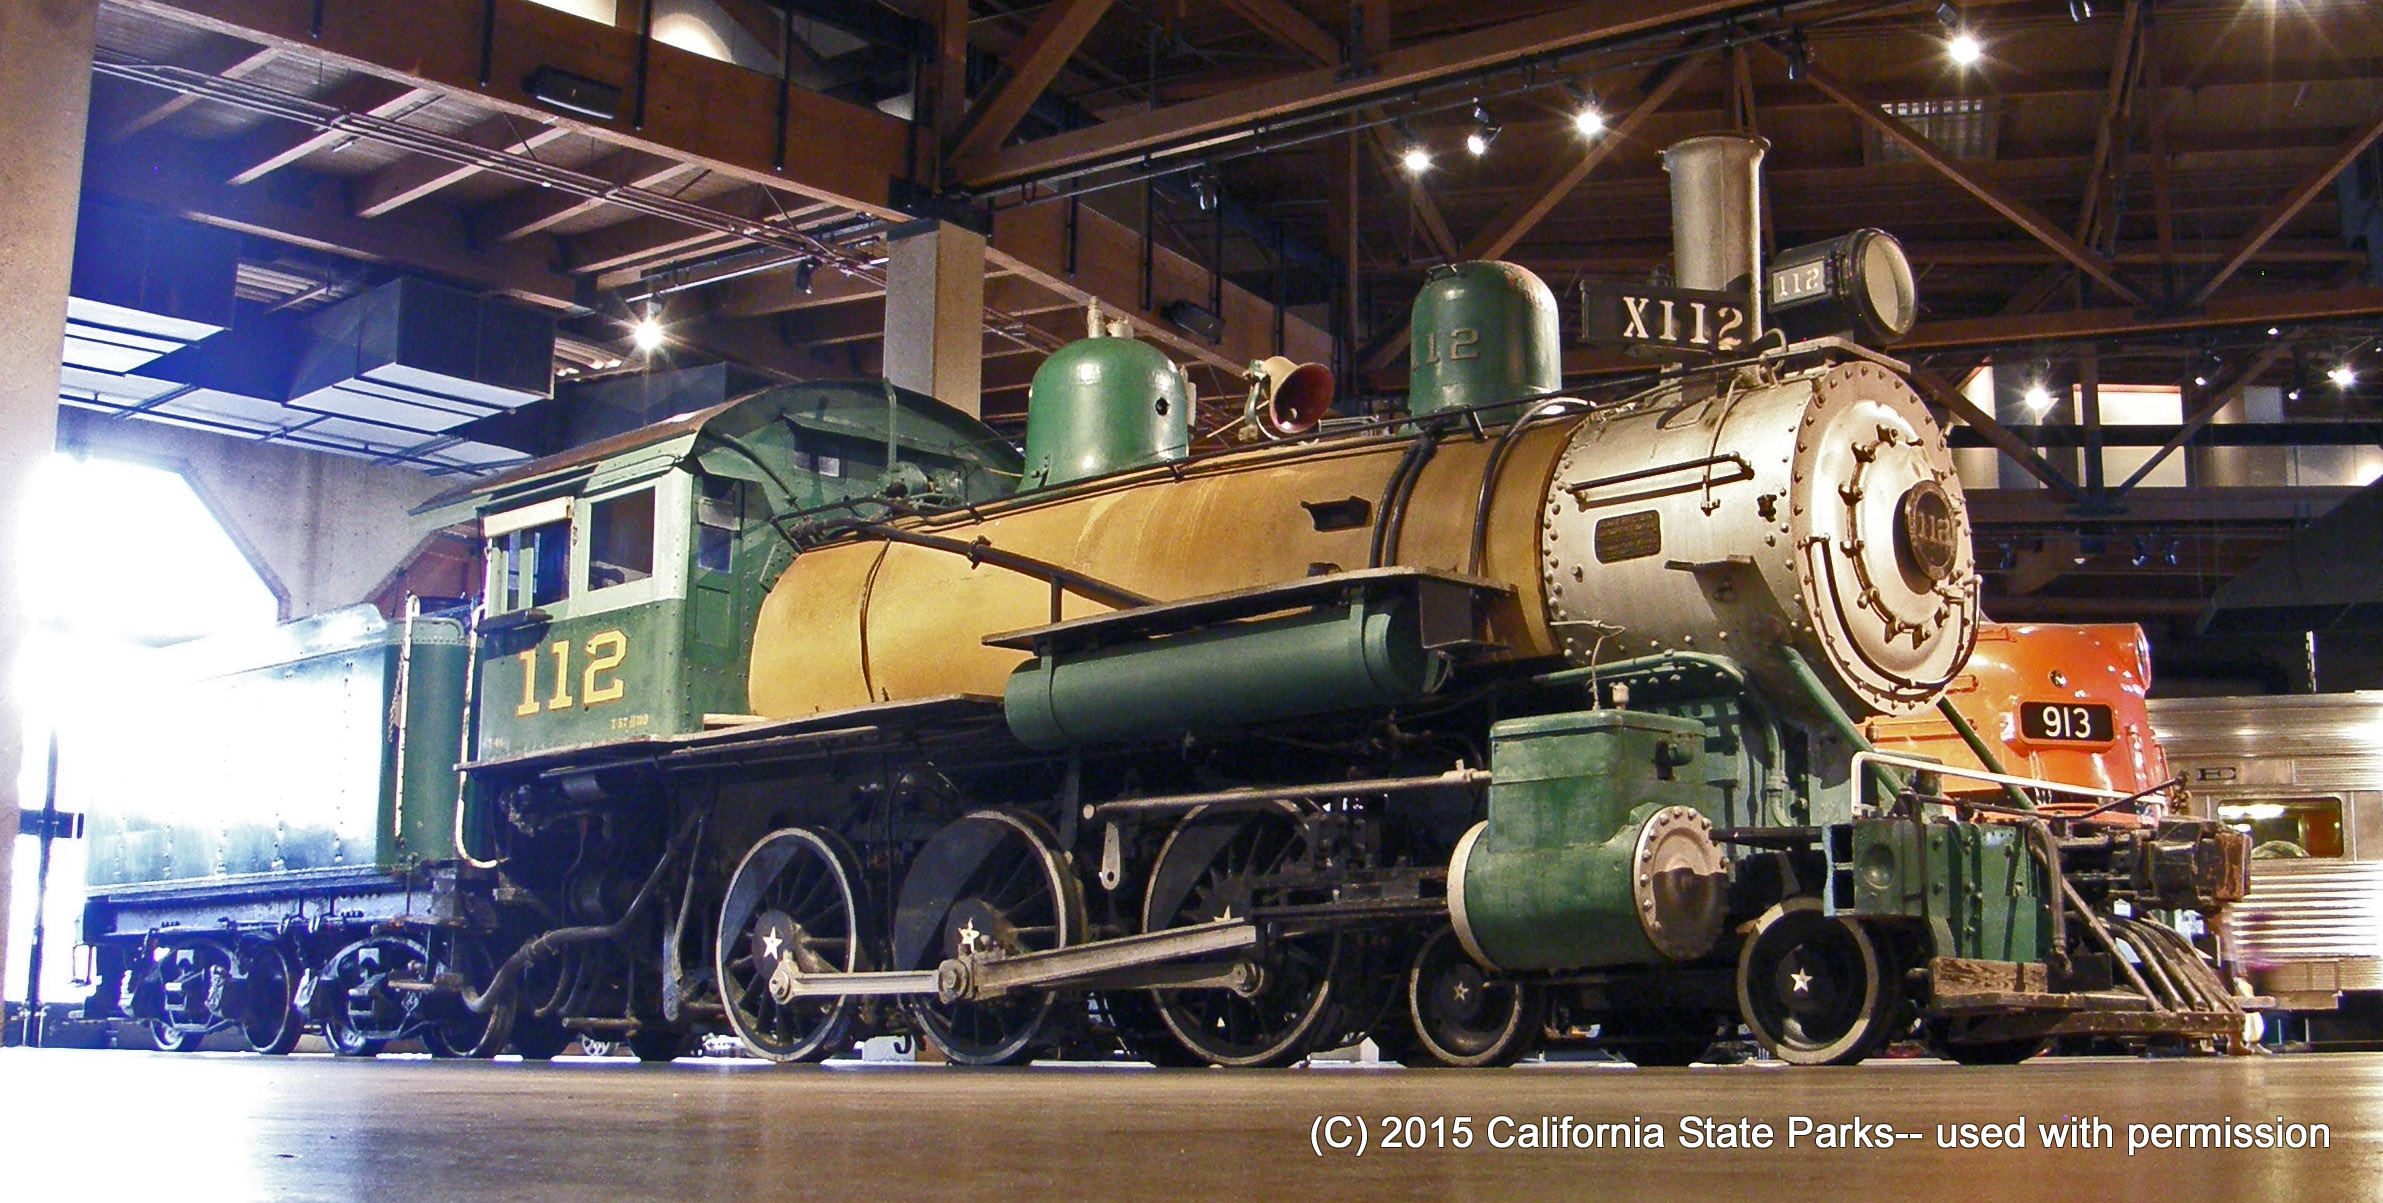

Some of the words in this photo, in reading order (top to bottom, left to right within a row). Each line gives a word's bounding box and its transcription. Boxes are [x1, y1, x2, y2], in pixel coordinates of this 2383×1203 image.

[1779, 267, 1820, 297] 112
[1623, 296, 1743, 351] X112
[1411, 328, 1480, 370] 12
[1917, 512, 1952, 547] 112
[516, 629, 628, 717] 112
[2043, 706, 2091, 738] 913
